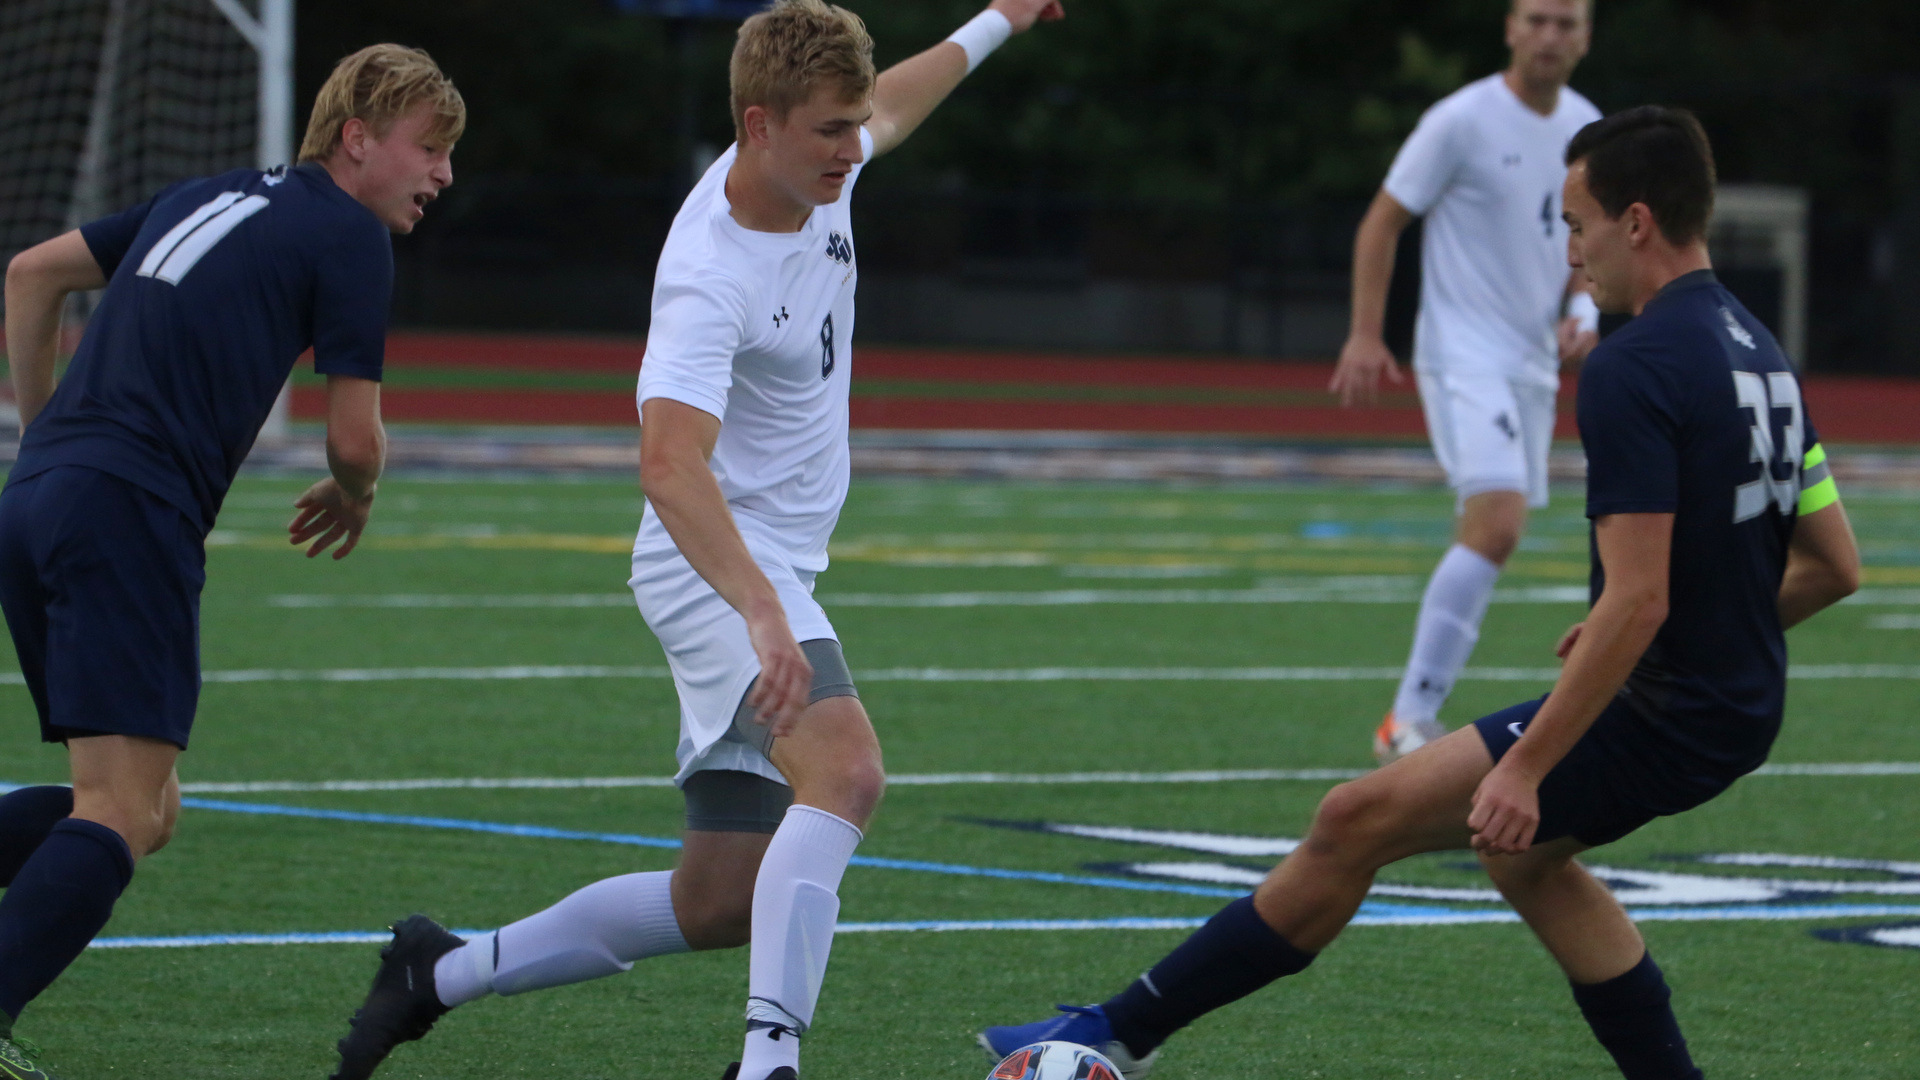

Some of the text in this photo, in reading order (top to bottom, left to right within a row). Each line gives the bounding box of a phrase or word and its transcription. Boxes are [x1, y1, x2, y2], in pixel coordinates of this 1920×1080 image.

[136, 191, 269, 286] 11
[1541, 192, 1554, 236] 4
[821, 311, 835, 380] 8
[1732, 371, 1805, 523] 33
